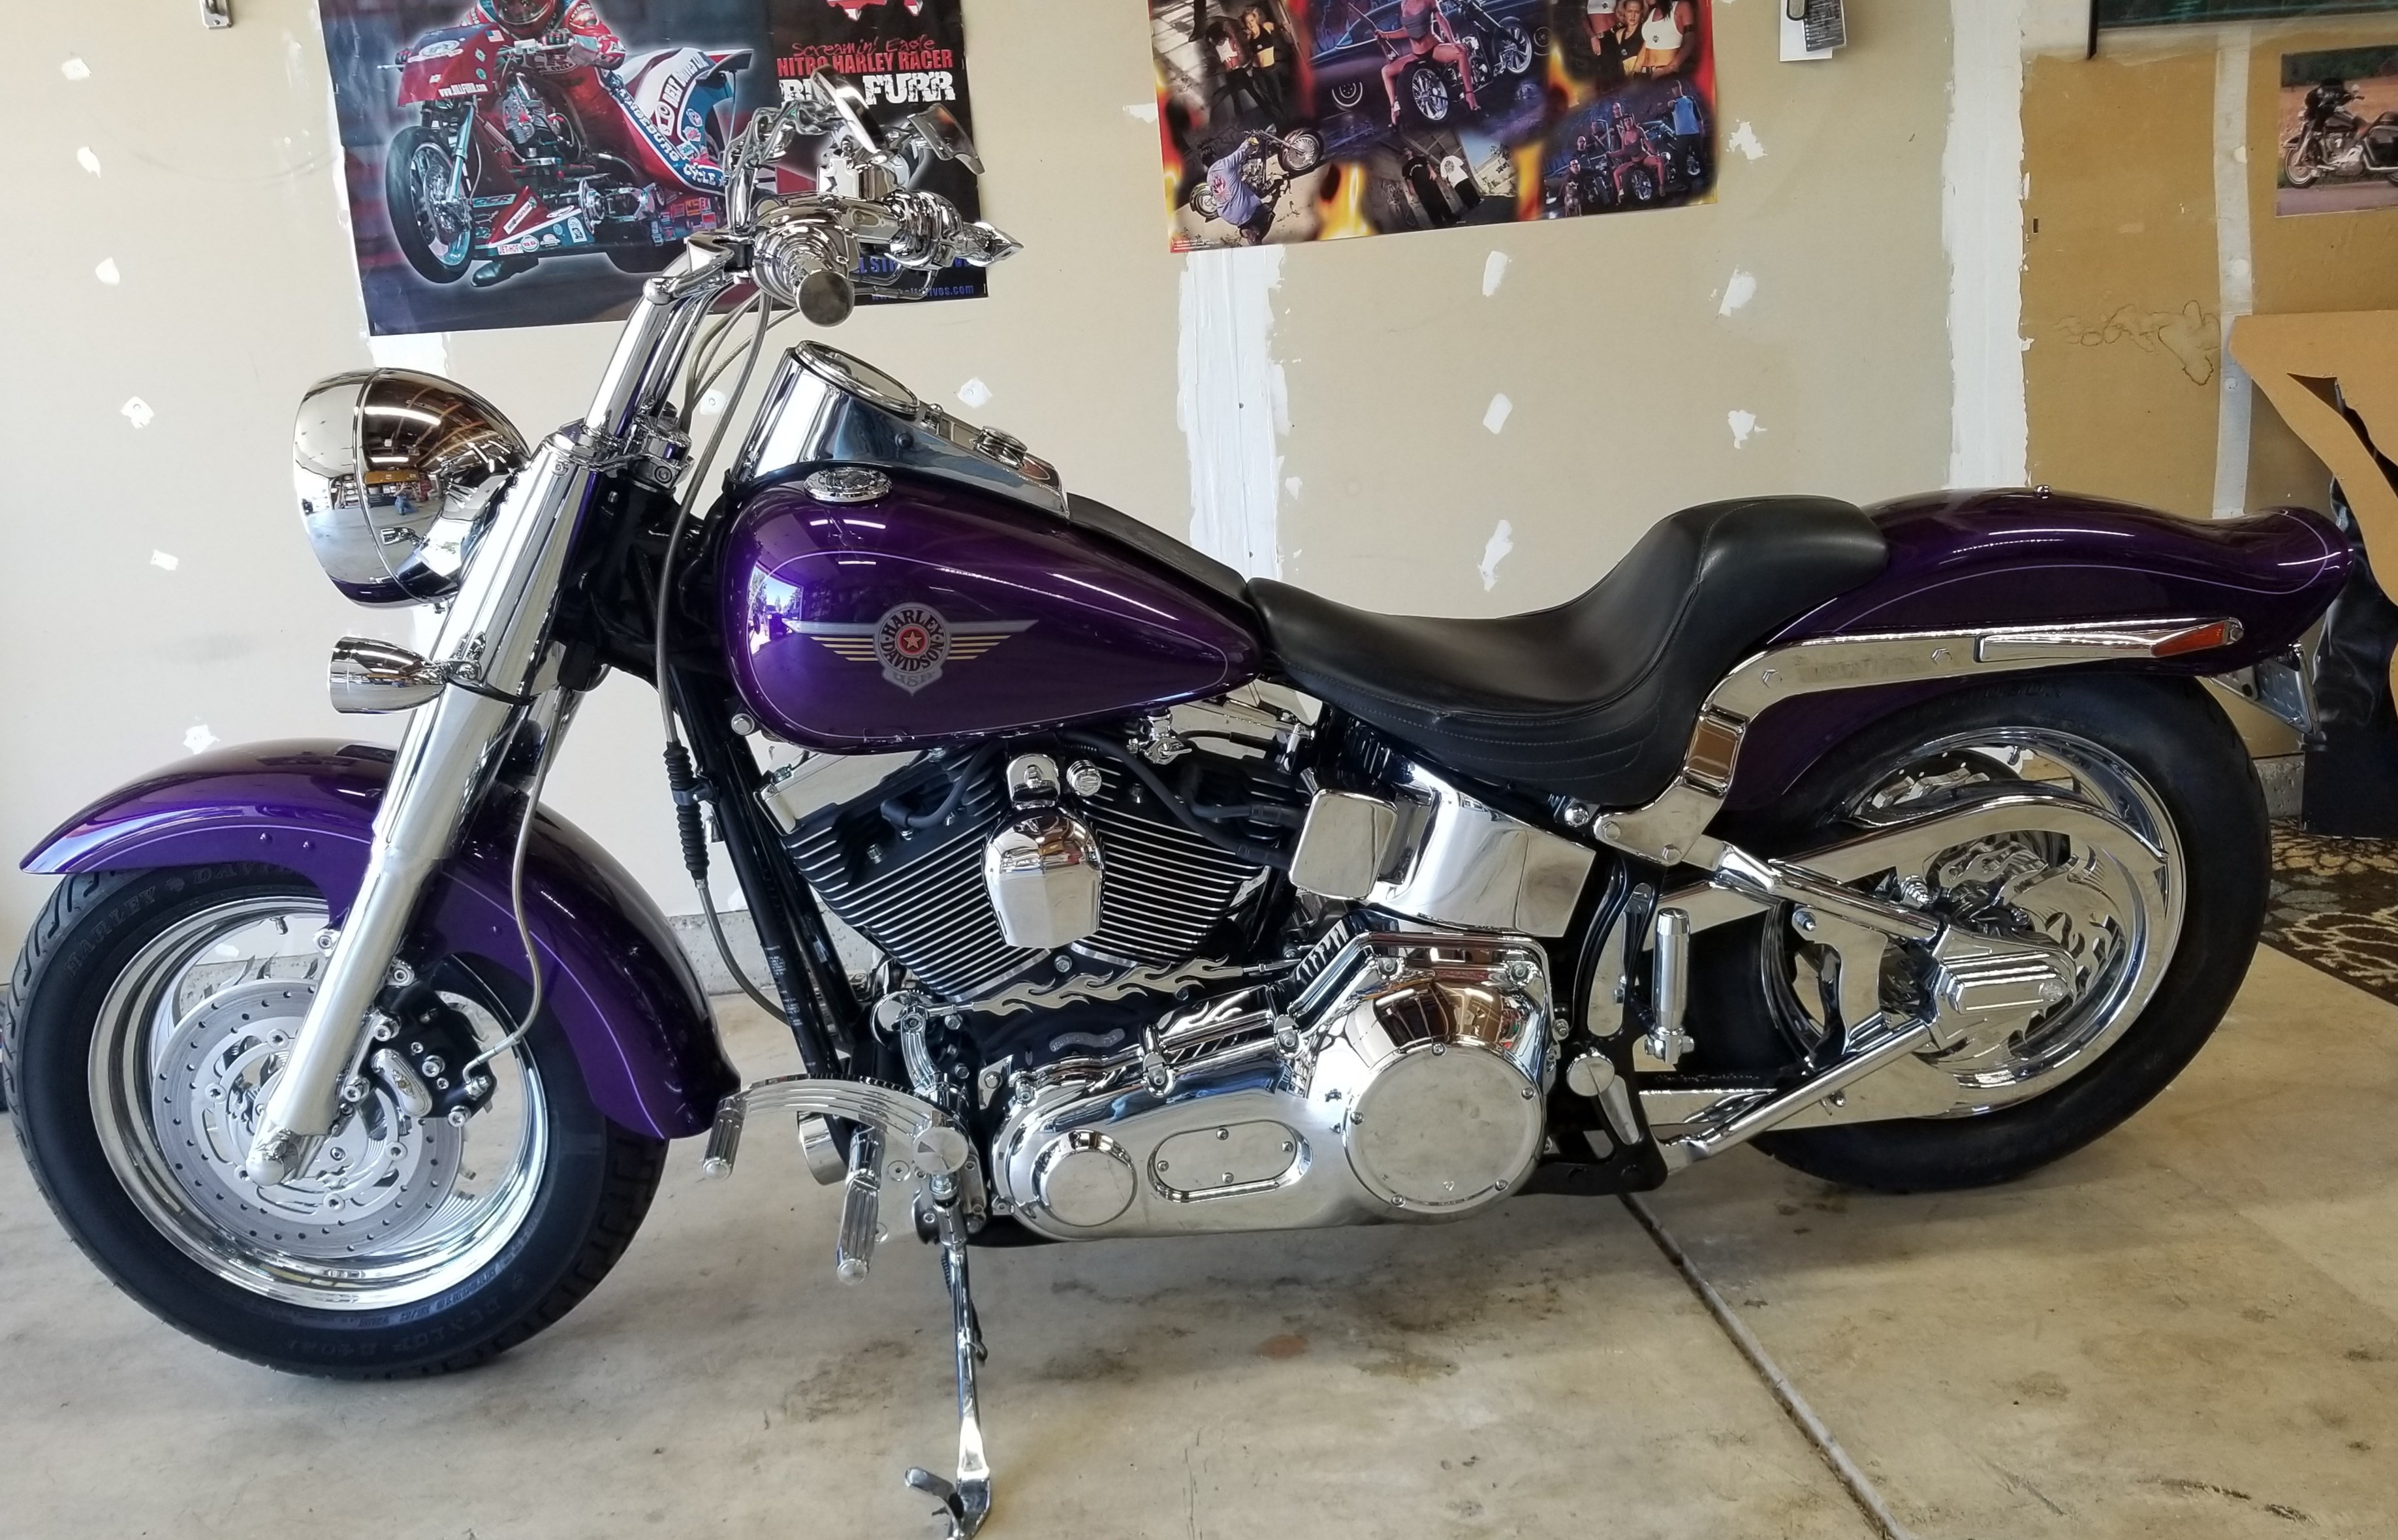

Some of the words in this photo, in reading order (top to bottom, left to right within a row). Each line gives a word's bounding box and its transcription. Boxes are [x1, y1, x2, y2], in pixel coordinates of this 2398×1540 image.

[792, 36, 878, 57] Screamin'
[832, 52, 893, 74] HARLEY
[898, 49, 953, 71] RACER
[862, 71, 956, 105] FURR
[615, 86, 680, 162] RANGEBURG
[684, 163, 717, 187] CYCLE
[881, 609, 945, 638] HARLEY
[880, 640, 945, 672] DAVIDSON
